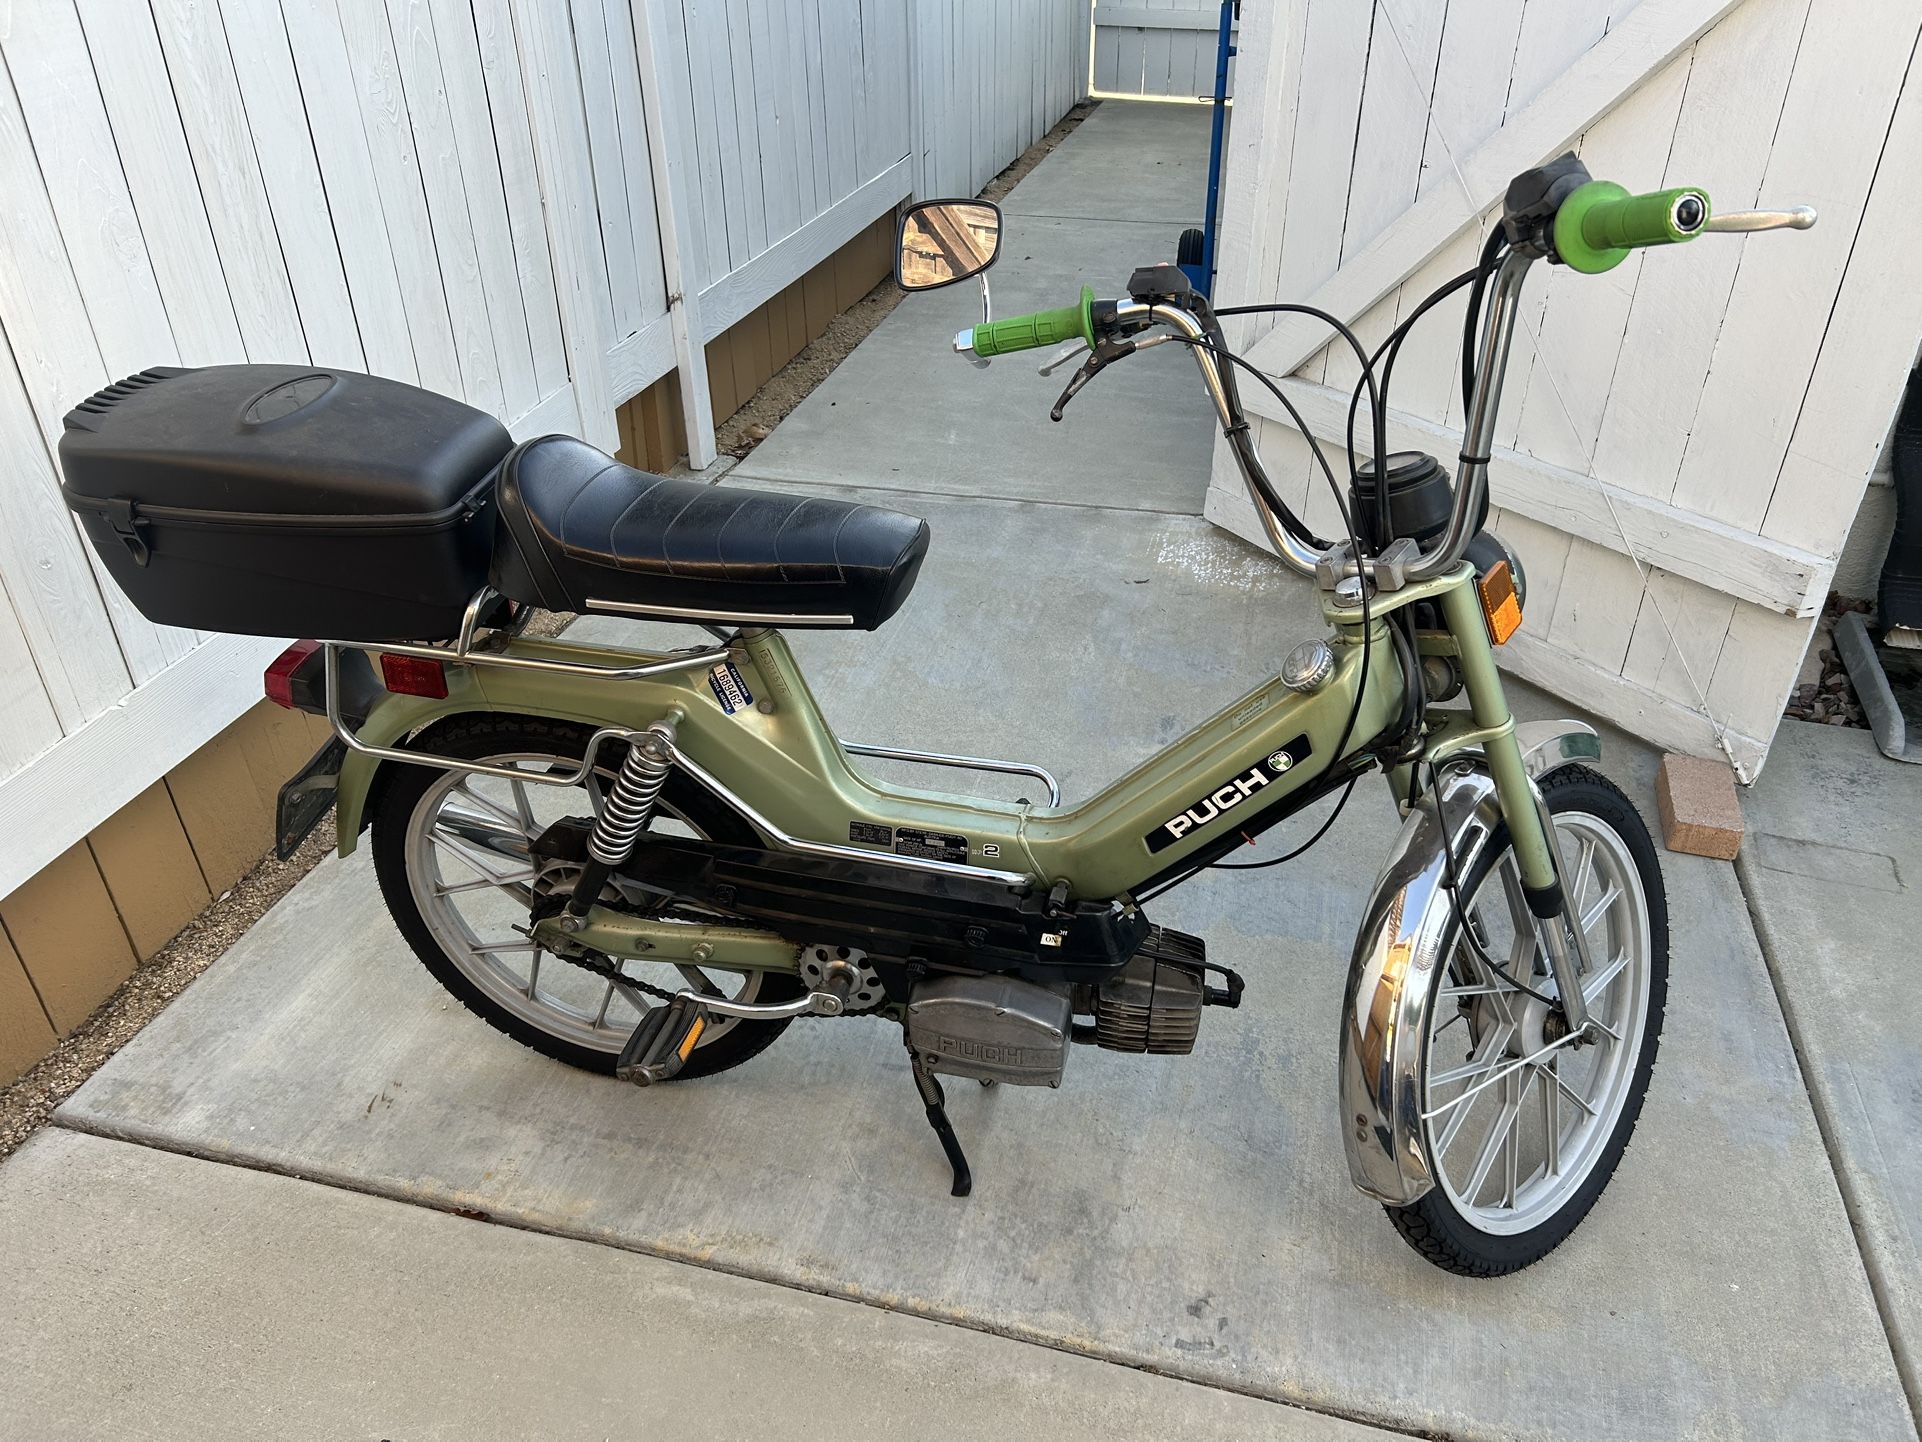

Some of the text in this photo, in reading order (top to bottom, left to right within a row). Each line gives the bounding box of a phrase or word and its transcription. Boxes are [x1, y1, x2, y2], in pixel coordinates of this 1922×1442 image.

[716, 668, 743, 706] 1689462
[730, 668, 750, 697] CALIFORNIA
[1164, 767, 1270, 839] PUCH
[983, 844, 999, 857] 2
[940, 1036, 1023, 1065] PUCH
